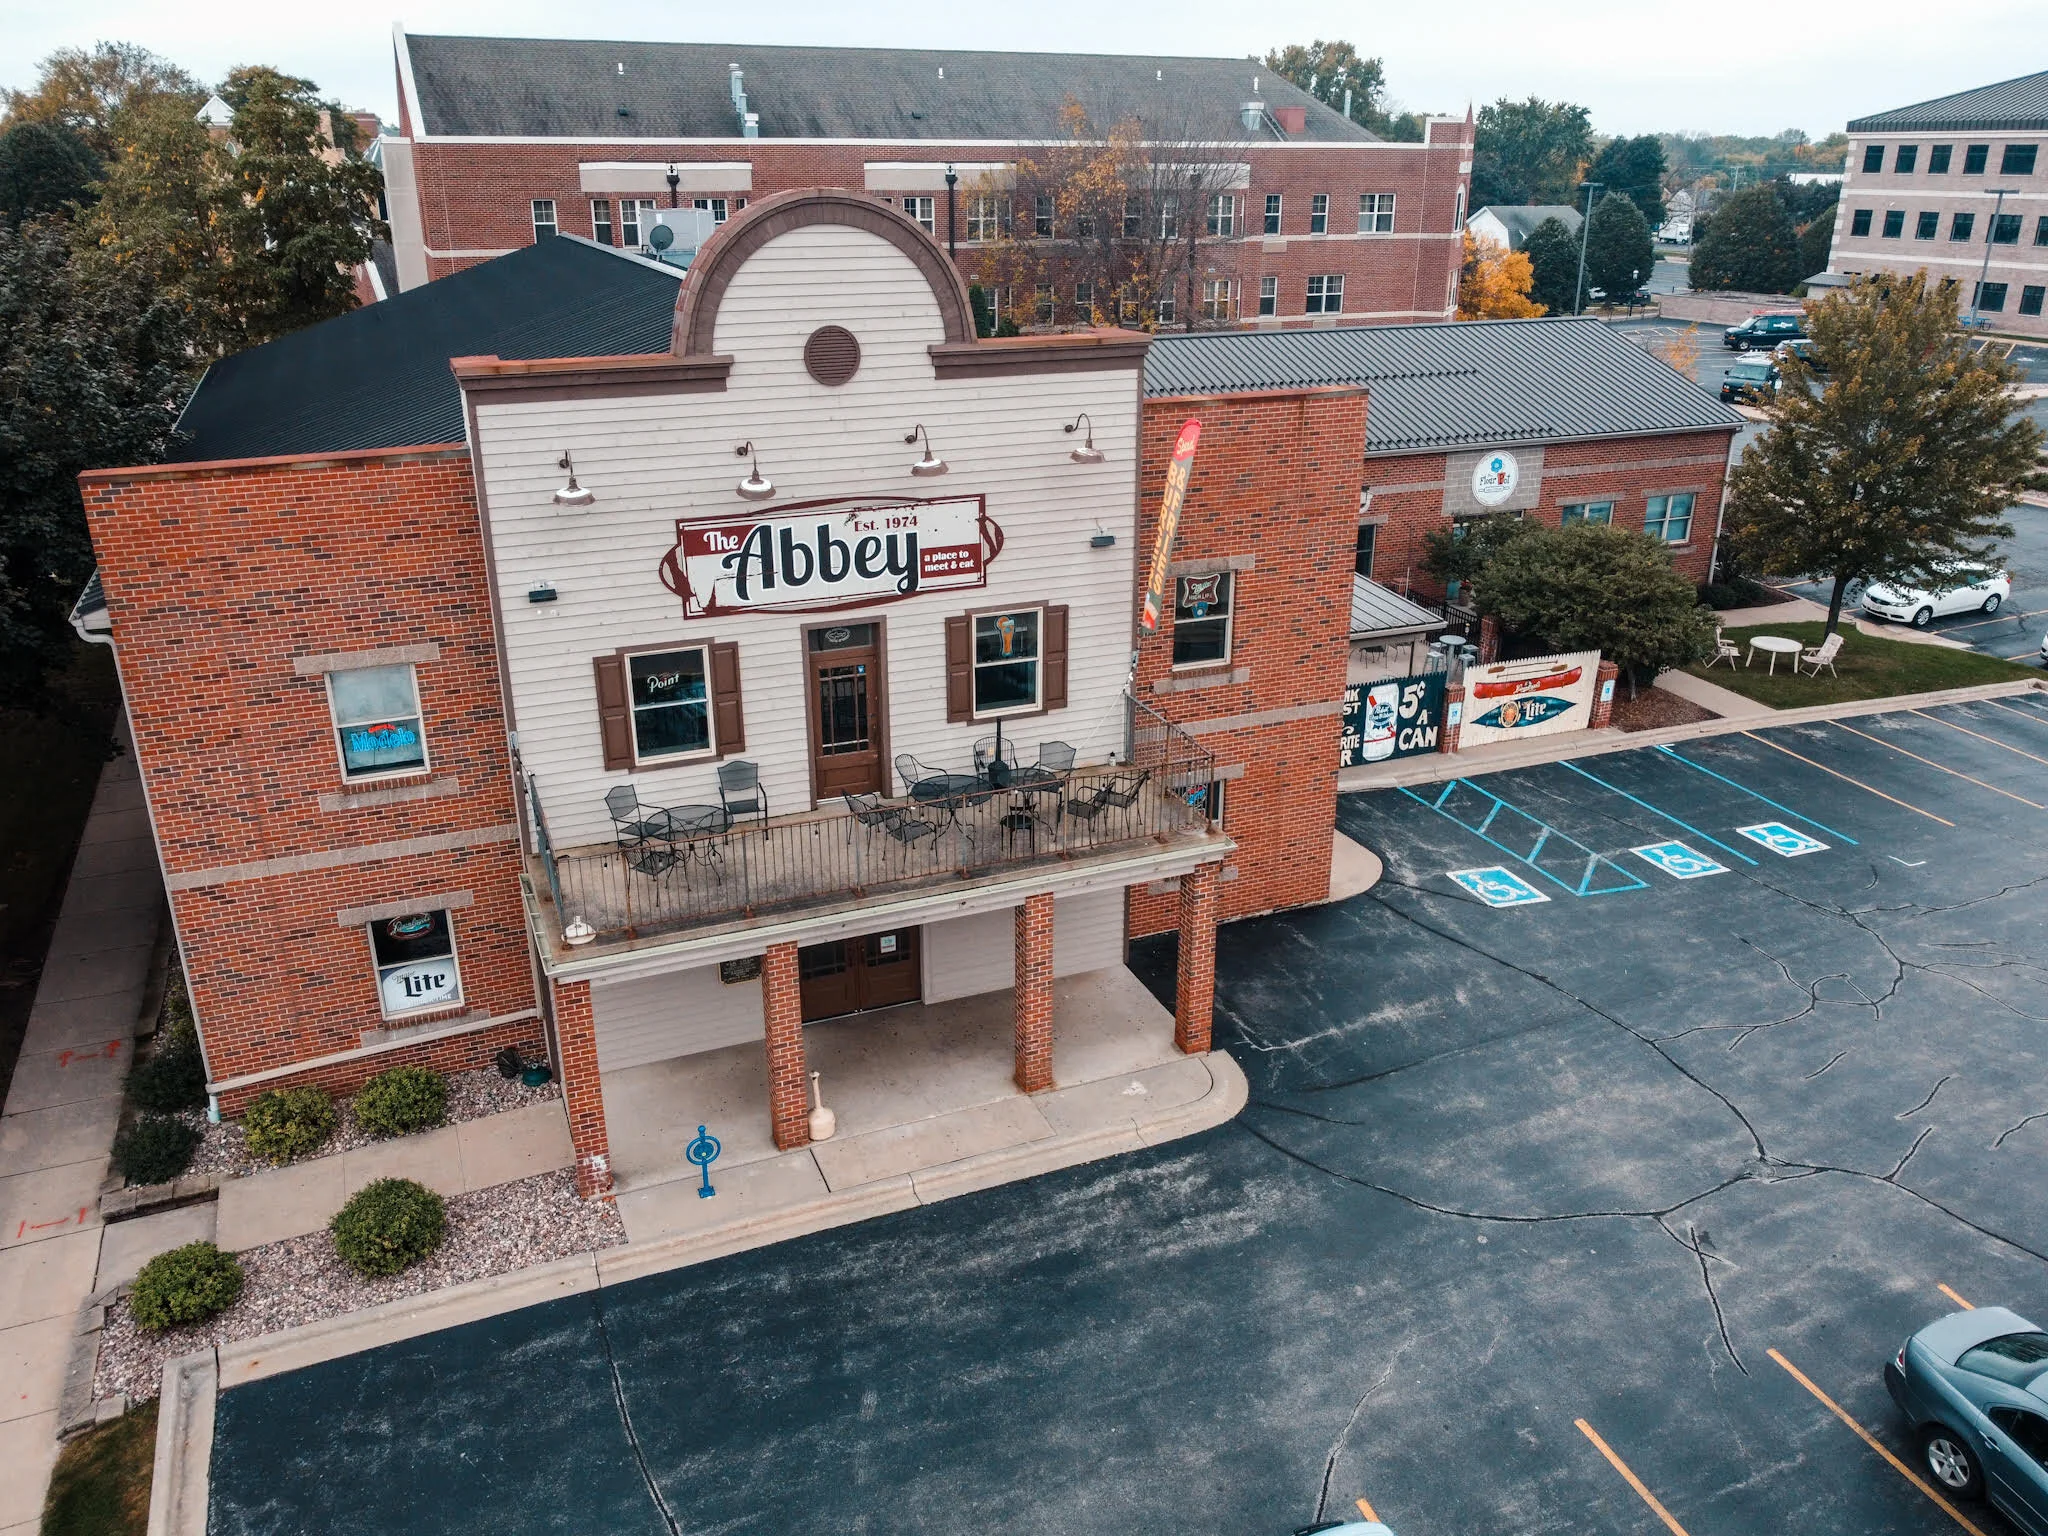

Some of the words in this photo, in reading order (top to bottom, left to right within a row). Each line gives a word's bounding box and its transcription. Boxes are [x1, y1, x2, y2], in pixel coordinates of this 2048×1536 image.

[854, 520, 879, 532] Est.
[885, 515, 918, 529] 1974
[703, 530, 739, 552] The
[721, 524, 919, 600] Abbey
[924, 554, 931, 562] a
[932, 551, 957, 562] place
[959, 550, 969, 559] to
[924, 561, 949, 572] meet
[950, 560, 957, 569] &
[959, 559, 974, 568] eat
[647, 673, 680, 693] Point
[1416, 709, 1428, 725] A
[1525, 702, 1547, 720] Lite
[351, 728, 416, 753] Modelo
[1398, 726, 1438, 751] CAN
[404, 974, 446, 997] Lite
